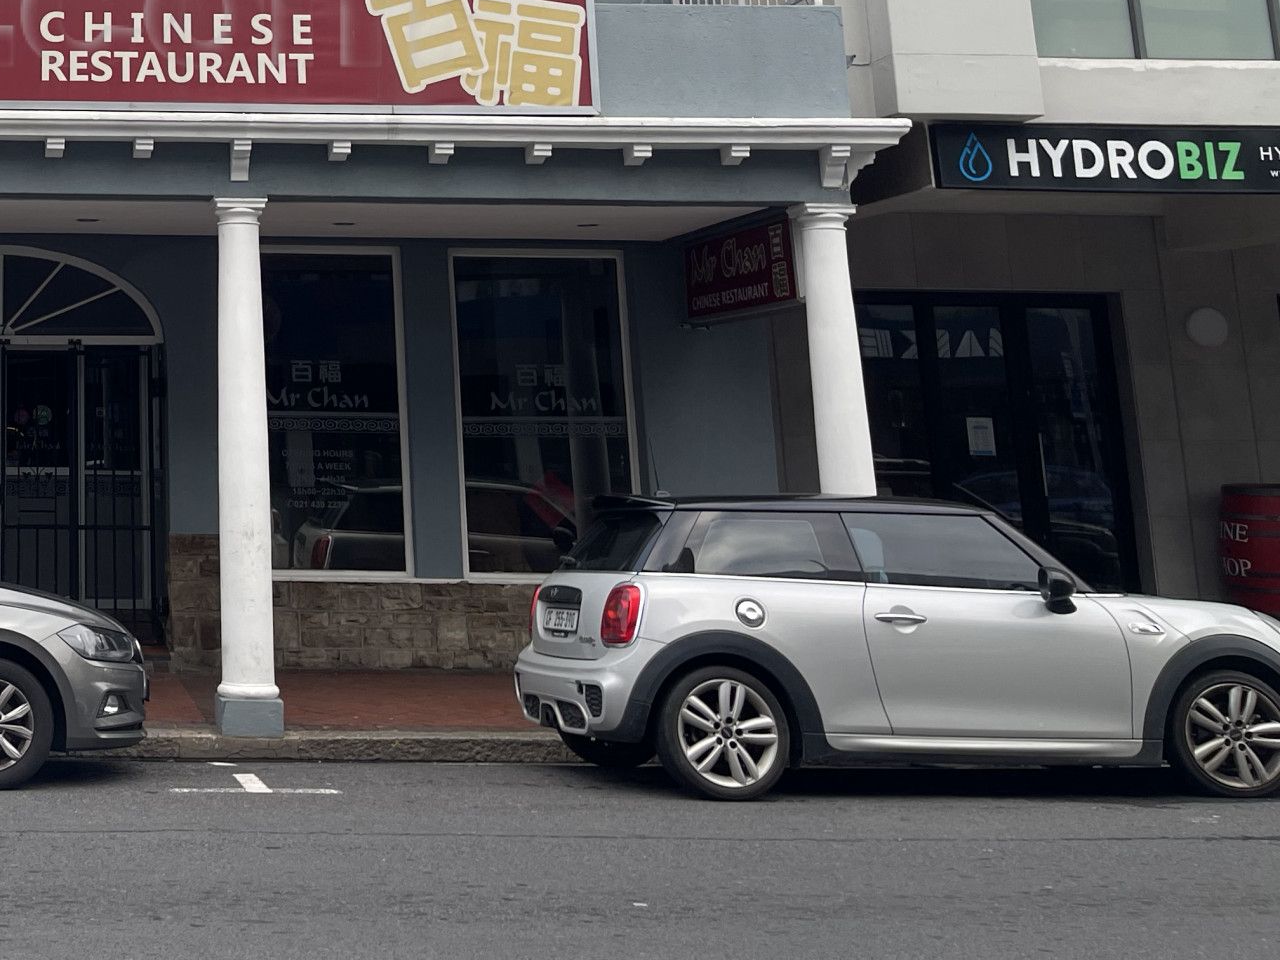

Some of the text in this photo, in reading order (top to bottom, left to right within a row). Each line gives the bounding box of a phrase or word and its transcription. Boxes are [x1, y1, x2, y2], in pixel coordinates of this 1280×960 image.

[40, 10, 314, 46] CHINESE
[40, 51, 315, 85] RESTAURANT
[1006, 138, 1245, 180] HYDROBIZ
[690, 237, 767, 285] Mr Chan
[692, 282, 769, 310] CHINESE RESTAURANT
[267, 385, 369, 408] Mr Chan
[490, 390, 597, 412] Mr Chan
[322, 449, 354, 458] HOURS
[324, 462, 352, 471] WEEK
[1219, 520, 1249, 543] INE
